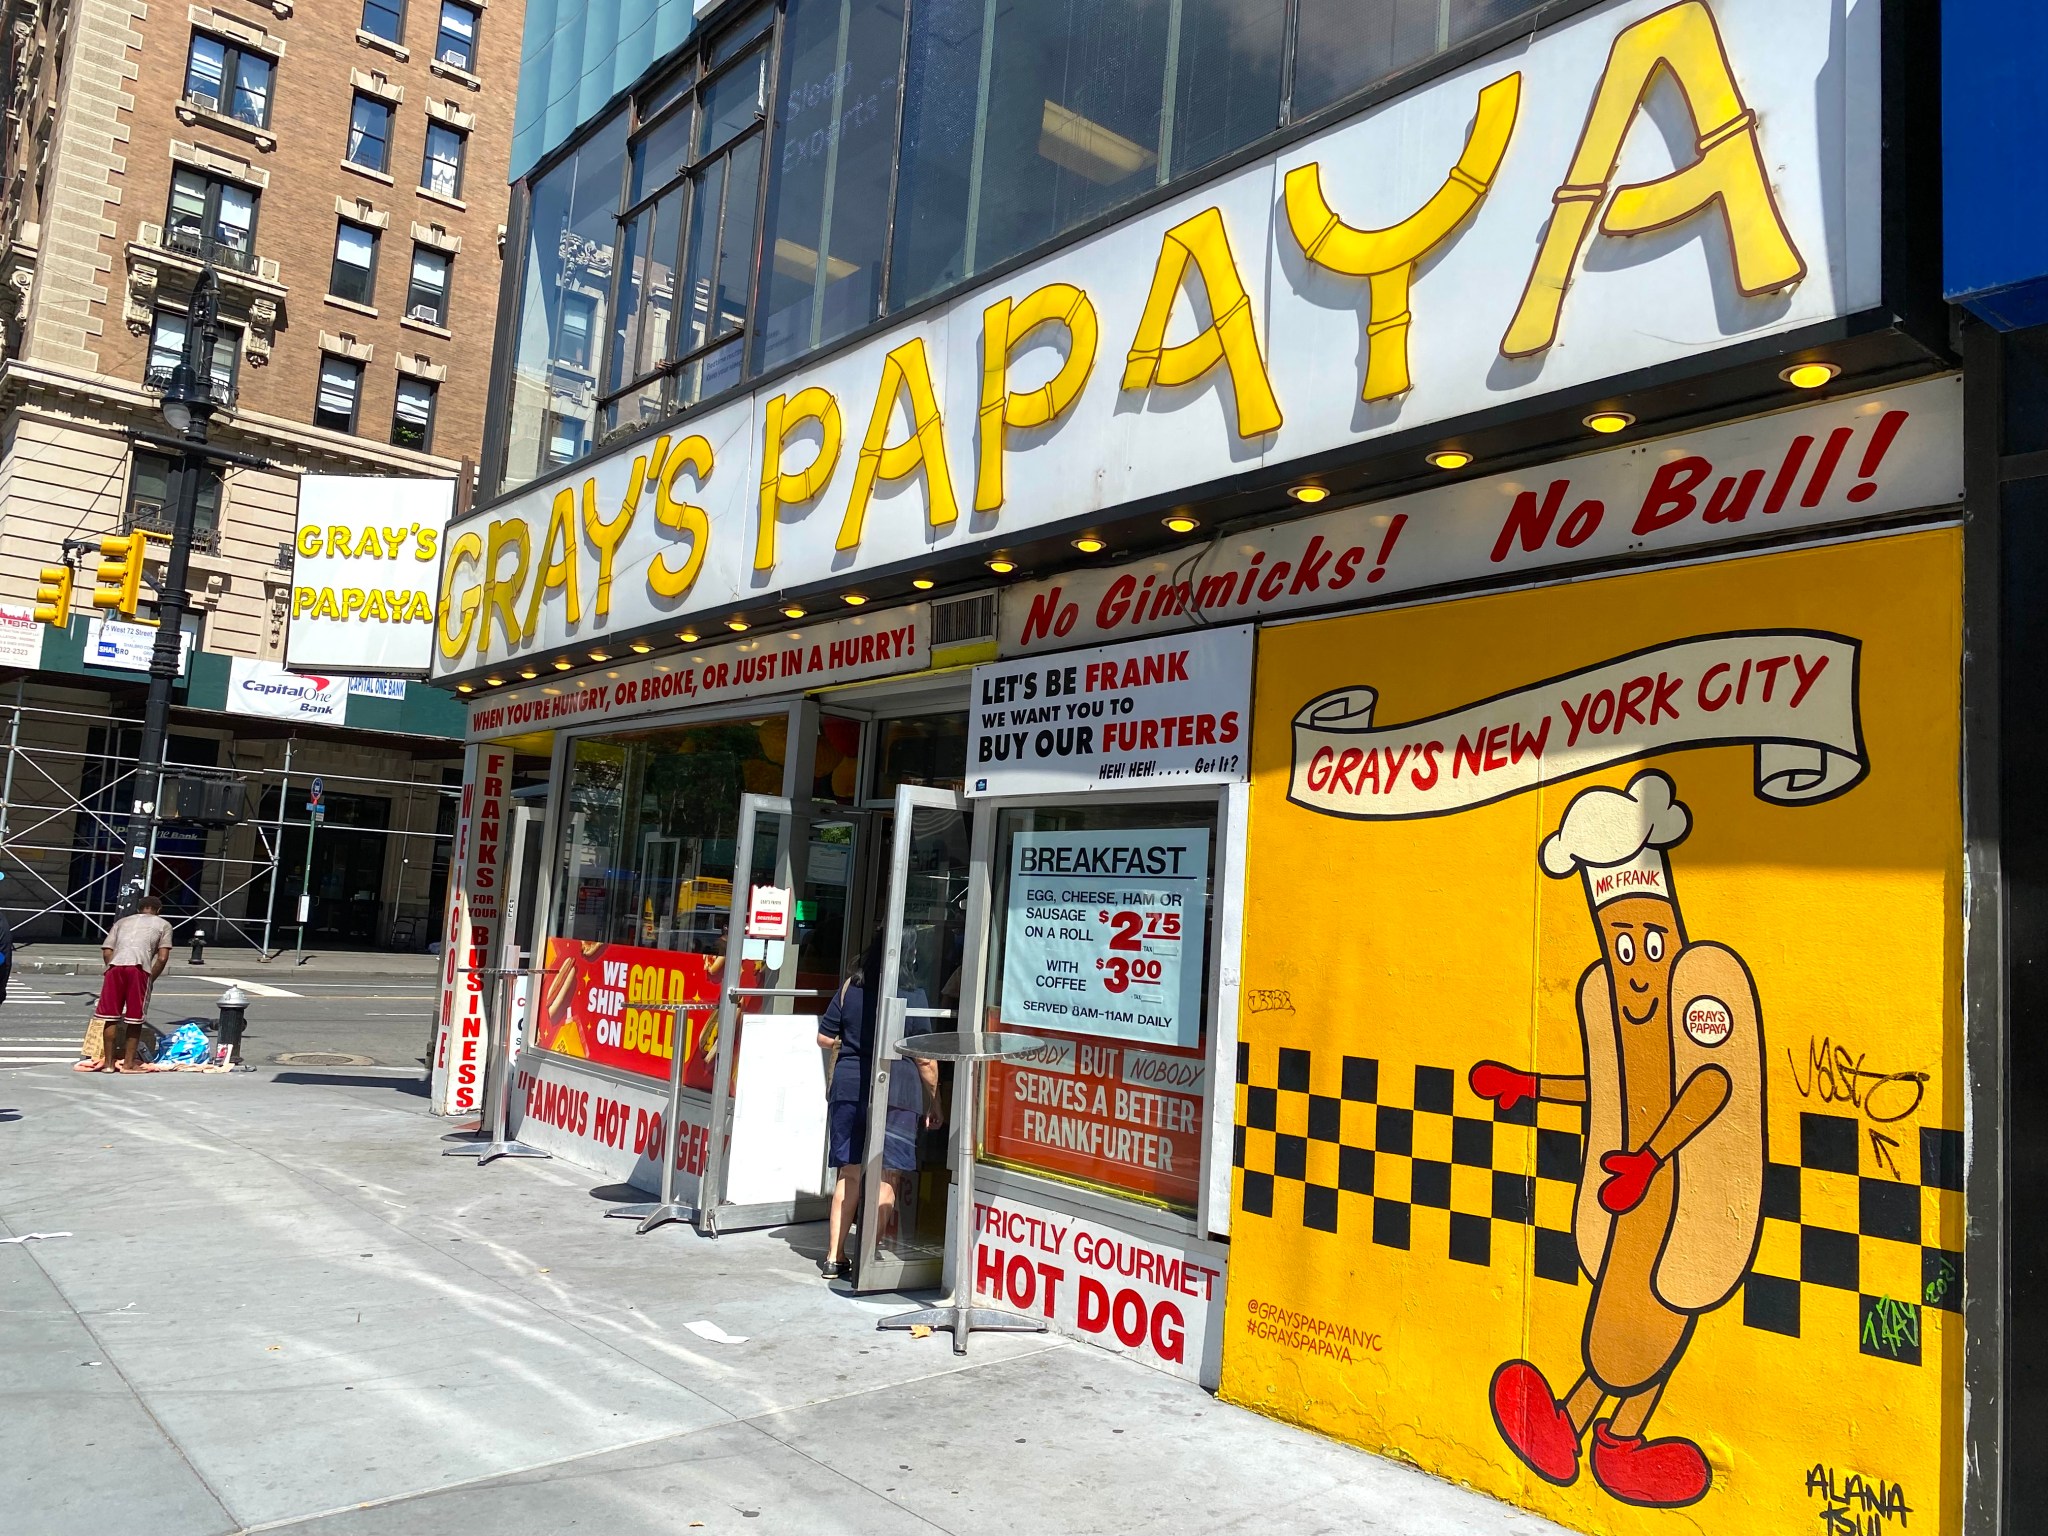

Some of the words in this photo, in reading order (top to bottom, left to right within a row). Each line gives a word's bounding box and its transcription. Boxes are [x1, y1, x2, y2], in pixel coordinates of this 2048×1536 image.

[439, 434, 713, 659] GRAY'S
[754, 0, 1807, 571] PAPAYA
[297, 523, 437, 561] GRAY'S
[1020, 586, 1079, 646] No
[1096, 514, 1408, 626] Gimmicks!
[1490, 479, 1604, 564] No
[1630, 410, 1910, 538] Bull!
[292, 587, 434, 624] PAPAYA
[111, 625, 126, 634] West
[127, 627, 134, 635] 72
[242, 680, 303, 697] Capital
[303, 687, 332, 703] One
[350, 677, 373, 693] CAPITAL
[375, 679, 387, 695] ONE
[388, 680, 404, 697] BANK
[473, 711, 504, 733] WHEN
[507, 701, 549, 725] YOU'RE
[551, 686, 610, 718] HUNGRY,
[614, 681, 637, 706] OR
[641, 669, 697, 702] BROKE,
[702, 663, 728, 690] OR
[732, 653, 777, 685] JUST
[781, 648, 803, 677] IN
[807, 645, 823, 673] A
[829, 624, 915, 670] HURRY!
[982, 672, 1037, 706] LET'S
[1045, 666, 1077, 698] BE
[1085, 650, 1190, 693] FRANK
[299, 702, 333, 715] Bank
[982, 711, 1005, 729] WE
[1010, 705, 1061, 726] WANT
[1066, 700, 1104, 720] YOU
[1110, 697, 1134, 716] TO
[979, 731, 1029, 763] BUY
[1034, 725, 1093, 758] OUR
[1102, 711, 1239, 753] FURTERS
[1307, 740, 1444, 796] GRAY'S
[1452, 715, 1552, 779] NEW
[1560, 671, 1684, 748] YORK
[1697, 654, 1830, 712] CITY
[1099, 762, 1124, 780] HEH!
[1194, 757, 1216, 774] Get
[1218, 755, 1239, 773] It?
[171, 832, 198, 840] Bank
[476, 754, 505, 888] FRANKS
[1020, 846, 1187, 874] BREAKFAST
[473, 894, 494, 904] FOR
[1027, 889, 1057, 903] EGG,
[1061, 891, 1118, 907] CHEESE,
[1122, 892, 1155, 906] HAM
[1160, 893, 1182, 907] OR
[1596, 875, 1614, 898] MR
[1616, 869, 1661, 888] FRANK
[469, 907, 497, 918] YOUR
[1025, 907, 1086, 922] SAUSAGE
[1025, 926, 1043, 938] ON
[1046, 927, 1056, 939] A
[1059, 928, 1094, 942] ROLL
[1046, 959, 1079, 974] WITH
[603, 960, 629, 988] WE
[628, 963, 685, 1006] GOLD
[1035, 975, 1087, 992] COFFEE
[456, 925, 489, 1108] BUSINESS
[587, 987, 625, 1017] SHIP
[1022, 1000, 1068, 1015] SERVED
[1071, 1005, 1134, 1023] 8AM-11AM
[1137, 1014, 1173, 1028] DAILY
[1689, 1010, 1726, 1023] GRAY'S
[596, 1018, 623, 1048] ON
[1690, 1022, 1728, 1035] PAPAYA
[1080, 1045, 1120, 1079] BUT
[1130, 1058, 1205, 1087] NOBODY
[1015, 1071, 1088, 1113] SERVES
[1092, 1085, 1108, 1118] A
[1115, 1088, 1195, 1134] BETTER
[594, 1097, 630, 1151] HOT
[634, 1107, 730, 1178] DOGER
[1023, 1108, 1174, 1172] FRANKFURTER
[974, 1203, 1068, 1255] TRICTLY
[1074, 1231, 1220, 1302] GOURMET
[976, 1243, 1065, 1319] HOT
[1077, 1274, 1185, 1365] DOG
[1247, 1299, 1383, 1352] @GRAYSPAPAYANYC
[1247, 1318, 1353, 1366] #GRAYSPAPAYA
[1805, 1463, 1914, 1528] ALANA
